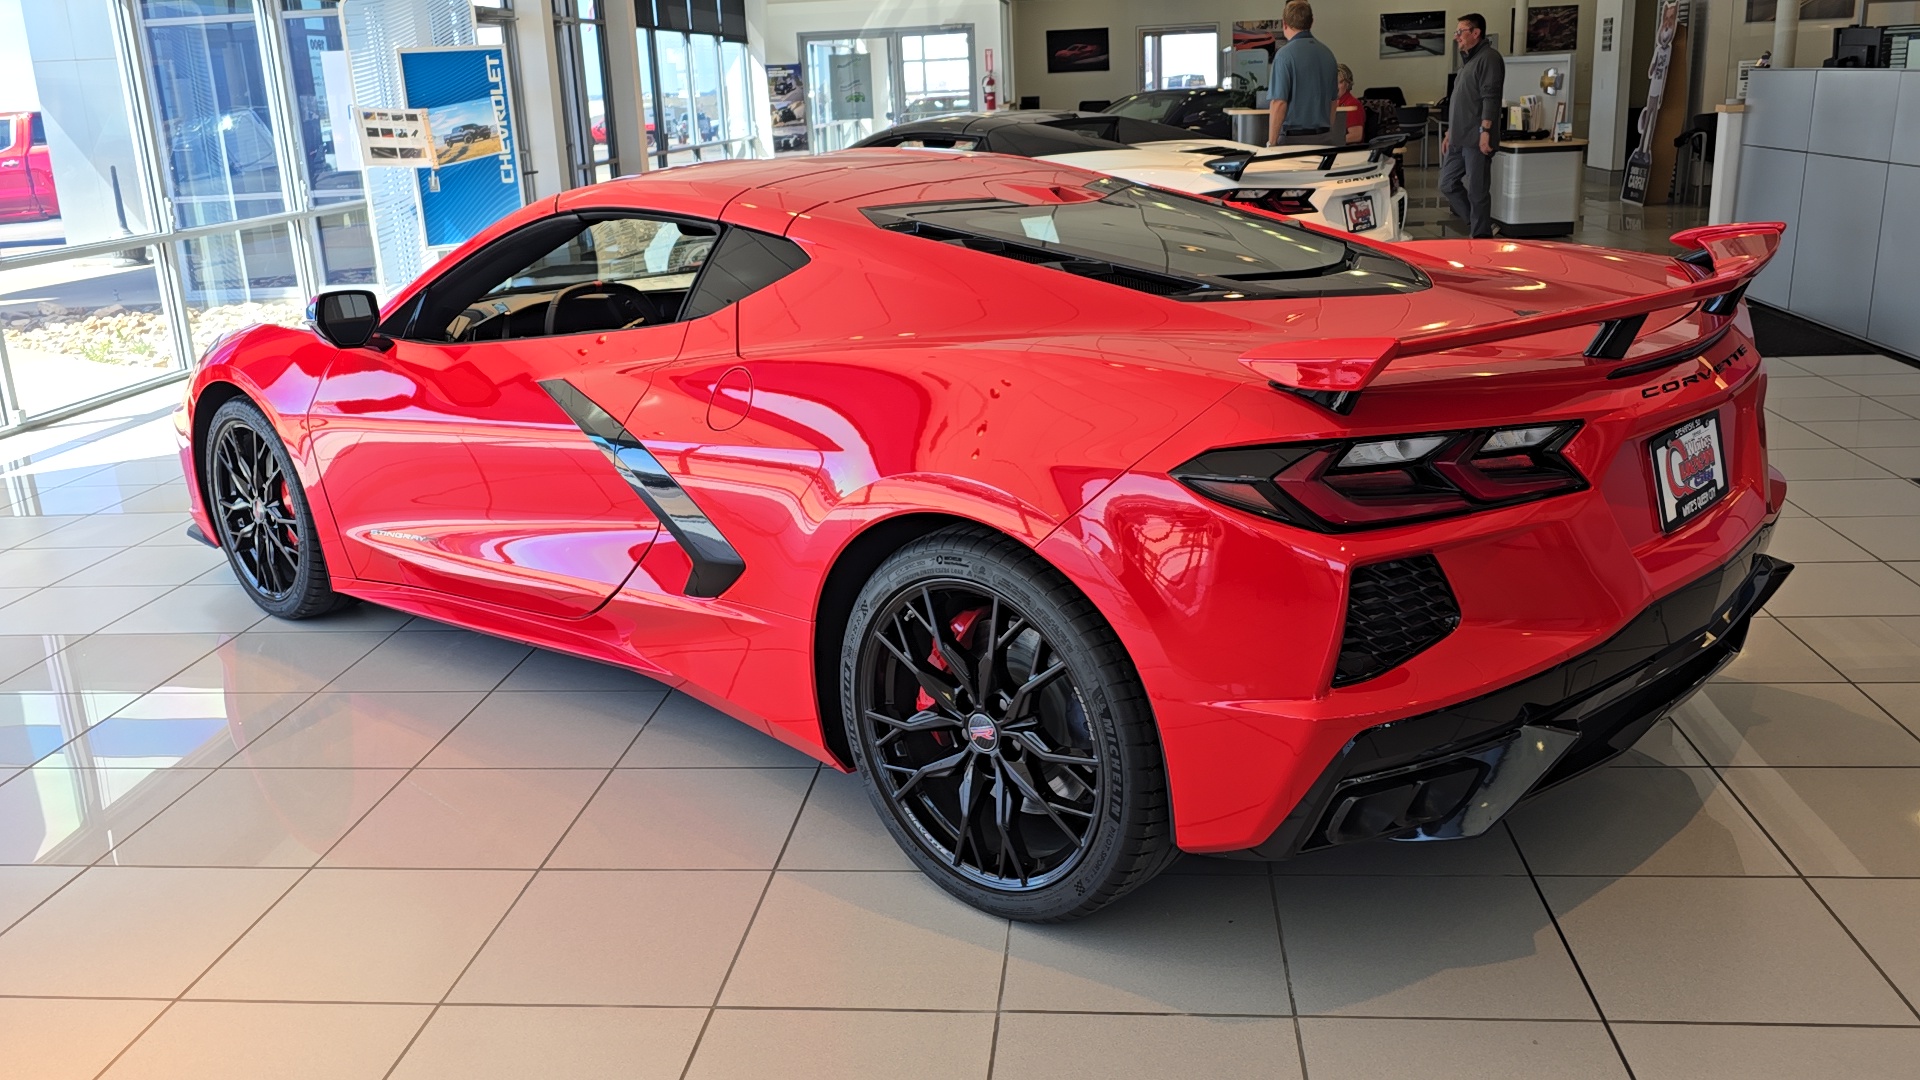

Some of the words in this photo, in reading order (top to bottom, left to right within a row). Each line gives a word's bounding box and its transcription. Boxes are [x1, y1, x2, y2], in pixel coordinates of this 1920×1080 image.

[485, 54, 515, 184] CHEVROLET
[1336, 172, 1383, 184] CORVETTE
[1641, 344, 1748, 399] CORVETTE
[370, 529, 427, 543] STINGRAY
[843, 660, 861, 754] MICHELIN
[1102, 717, 1122, 818] MICHELIN
